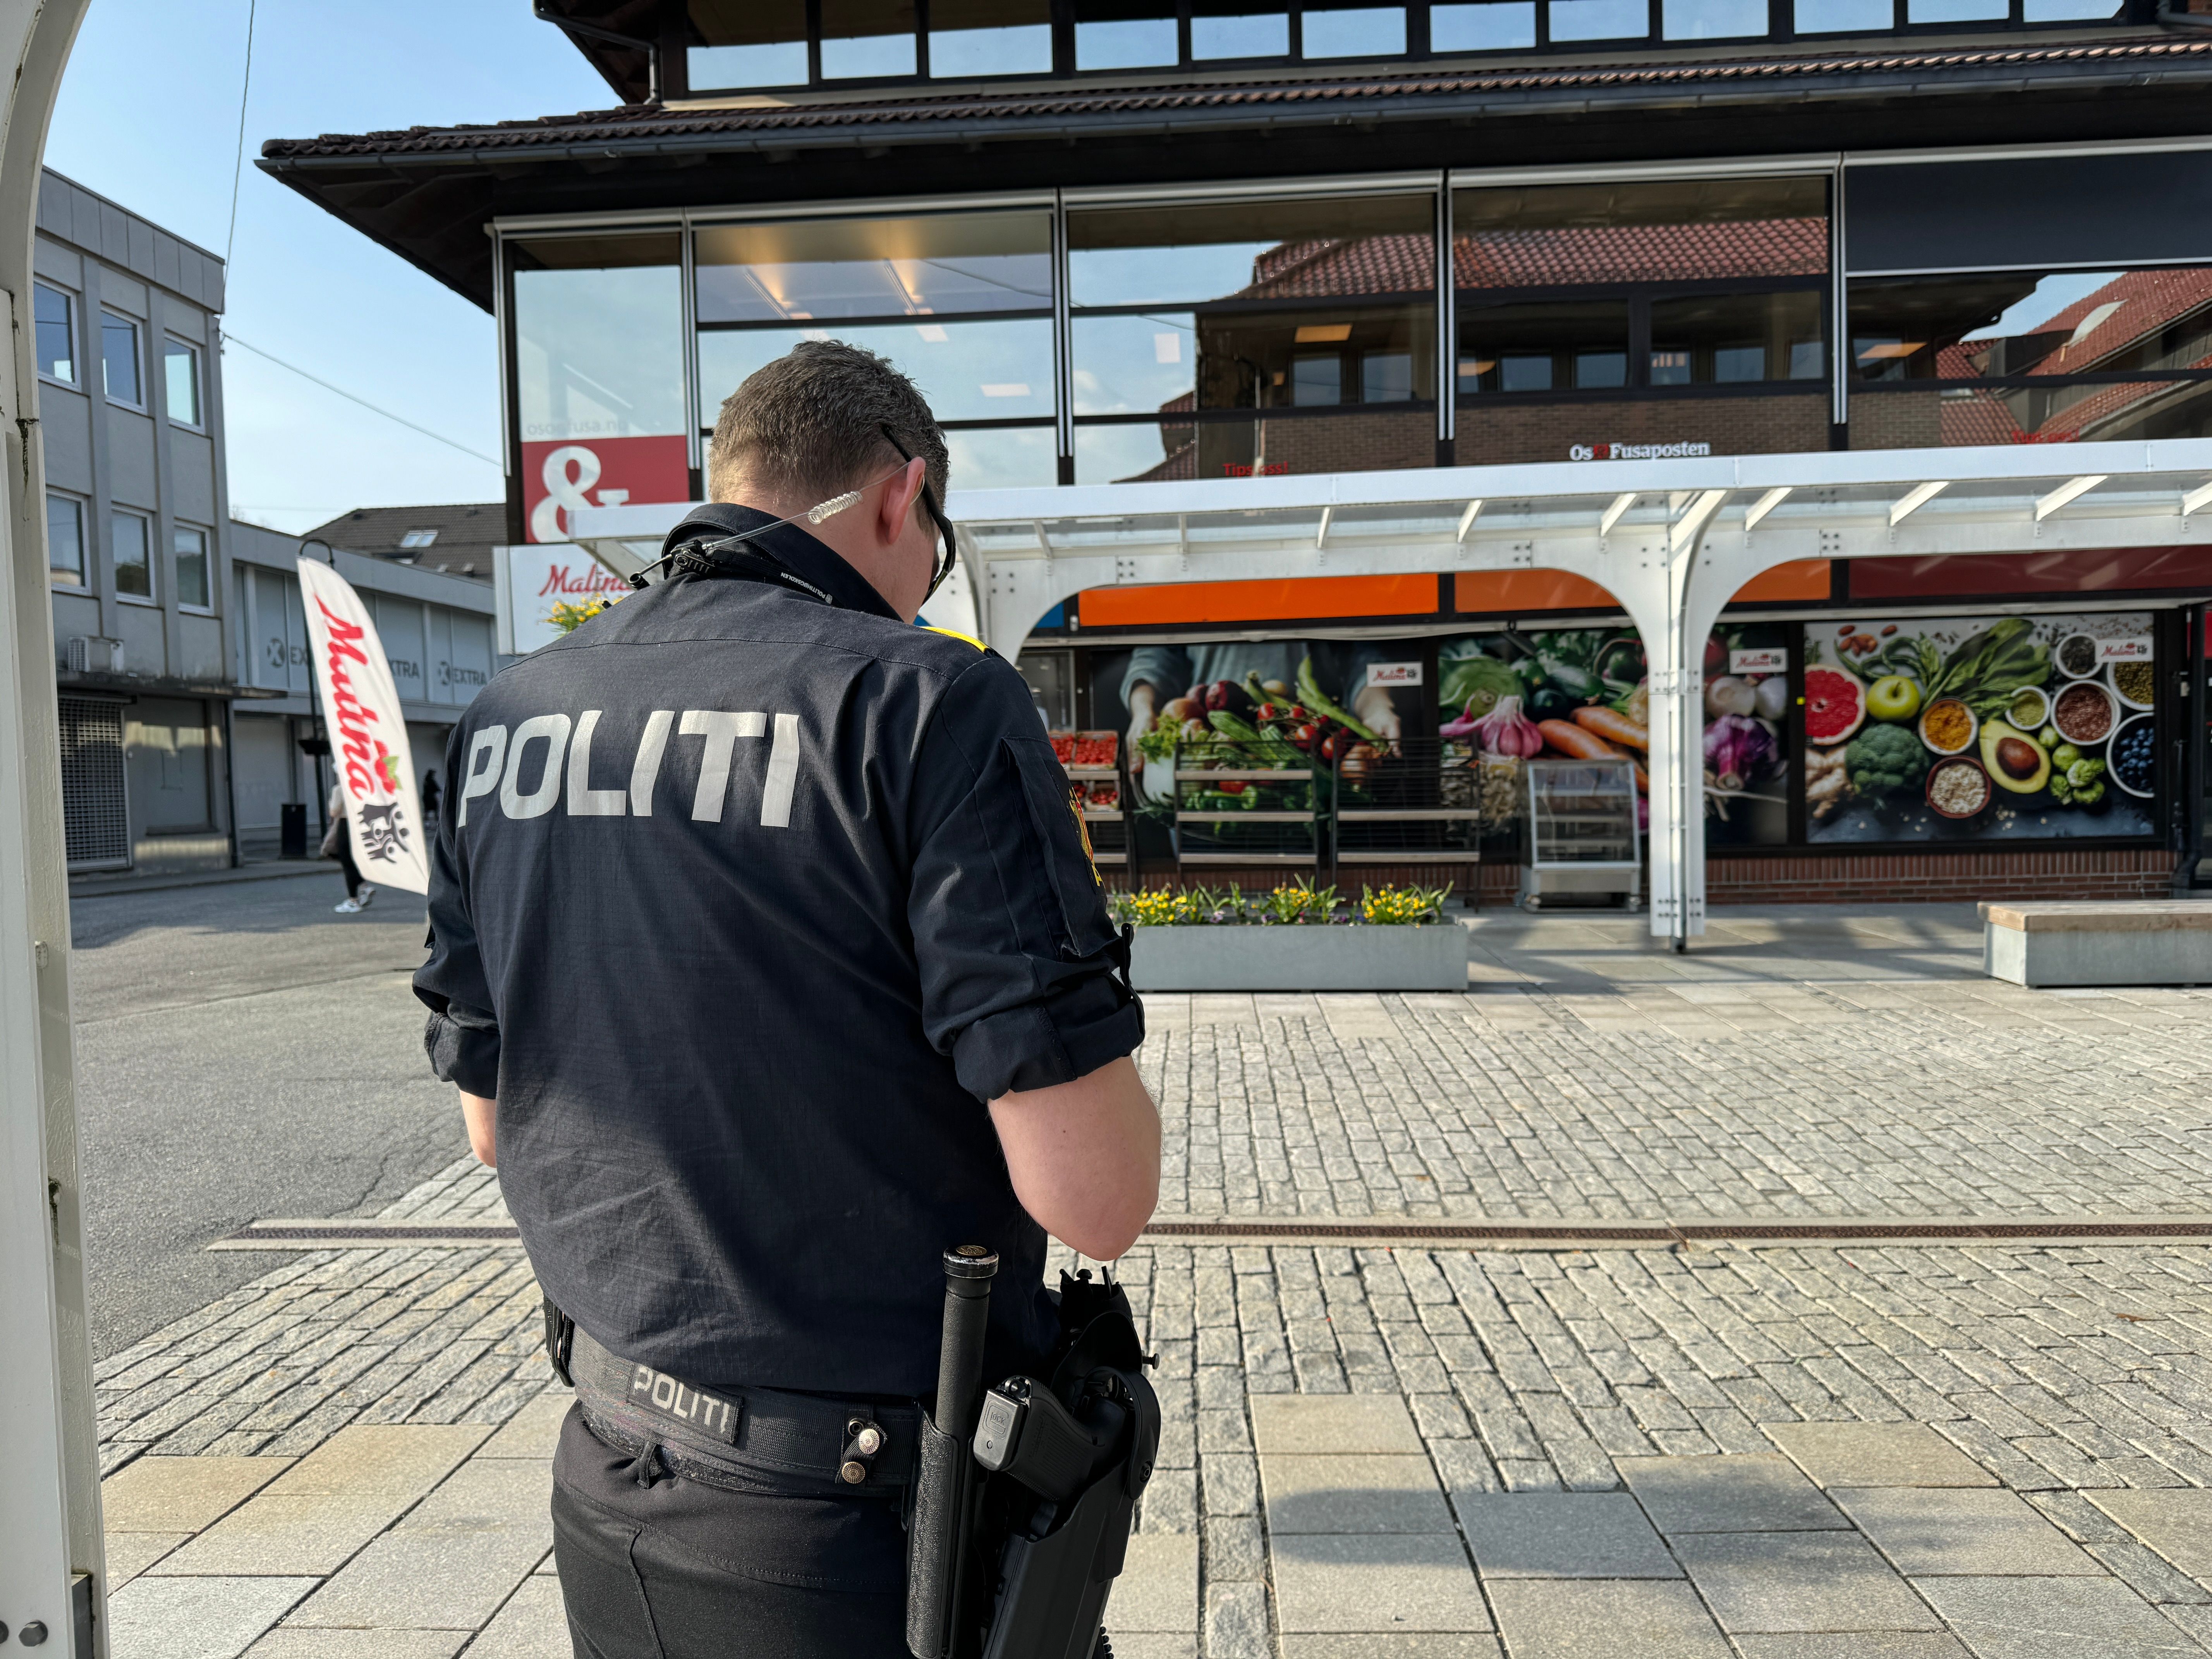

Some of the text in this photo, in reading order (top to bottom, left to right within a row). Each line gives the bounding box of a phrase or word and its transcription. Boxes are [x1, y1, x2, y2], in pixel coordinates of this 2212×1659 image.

[1223, 463, 1253, 477] Tips
[388, 659, 419, 678] XTRA
[458, 710, 800, 828] POLITI
[634, 1365, 730, 1433] POLITI
